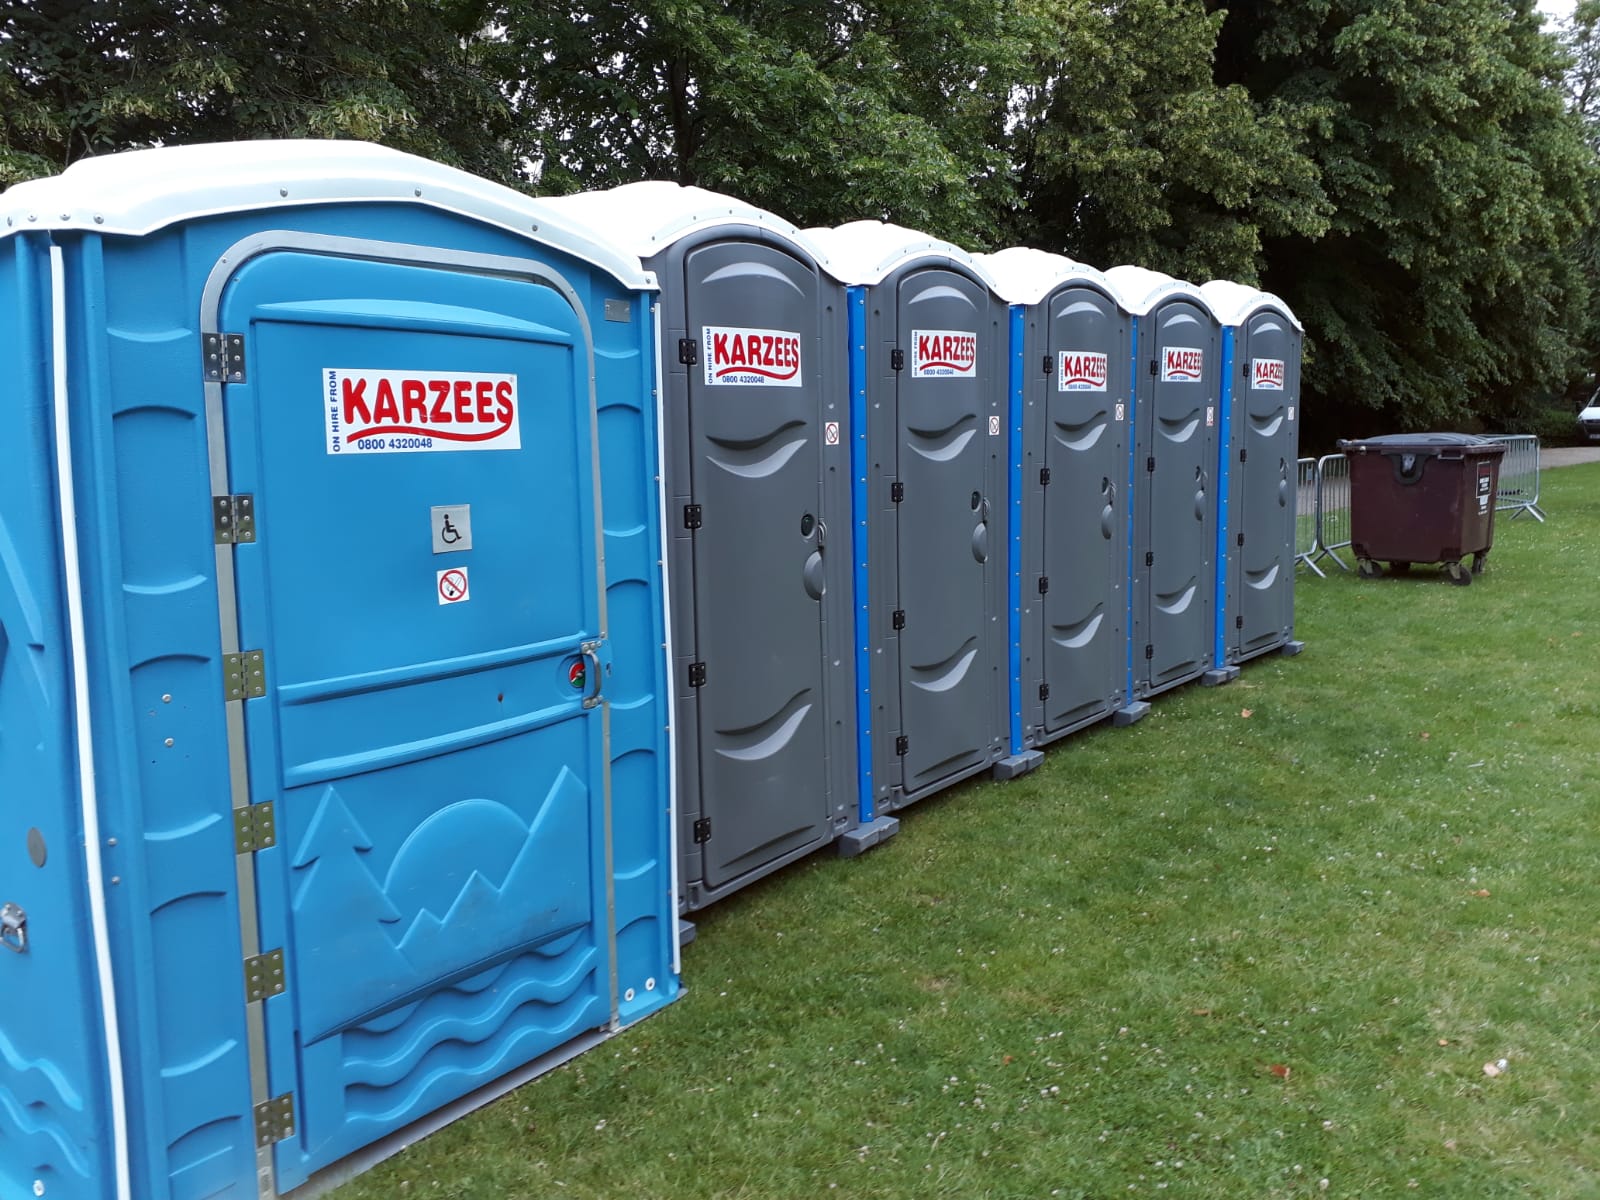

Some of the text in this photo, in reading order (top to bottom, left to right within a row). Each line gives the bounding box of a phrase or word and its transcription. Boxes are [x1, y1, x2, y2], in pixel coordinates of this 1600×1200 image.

[714, 333, 799, 368] KARZEES
[919, 335, 975, 361] KARZEES
[1064, 355, 1106, 378] KARZEES
[1256, 361, 1284, 380] KARZE
[328, 371, 341, 452] ON HIRE FROM
[342, 378, 514, 427] KARZEES
[358, 438, 433, 450] 0800 4320048
